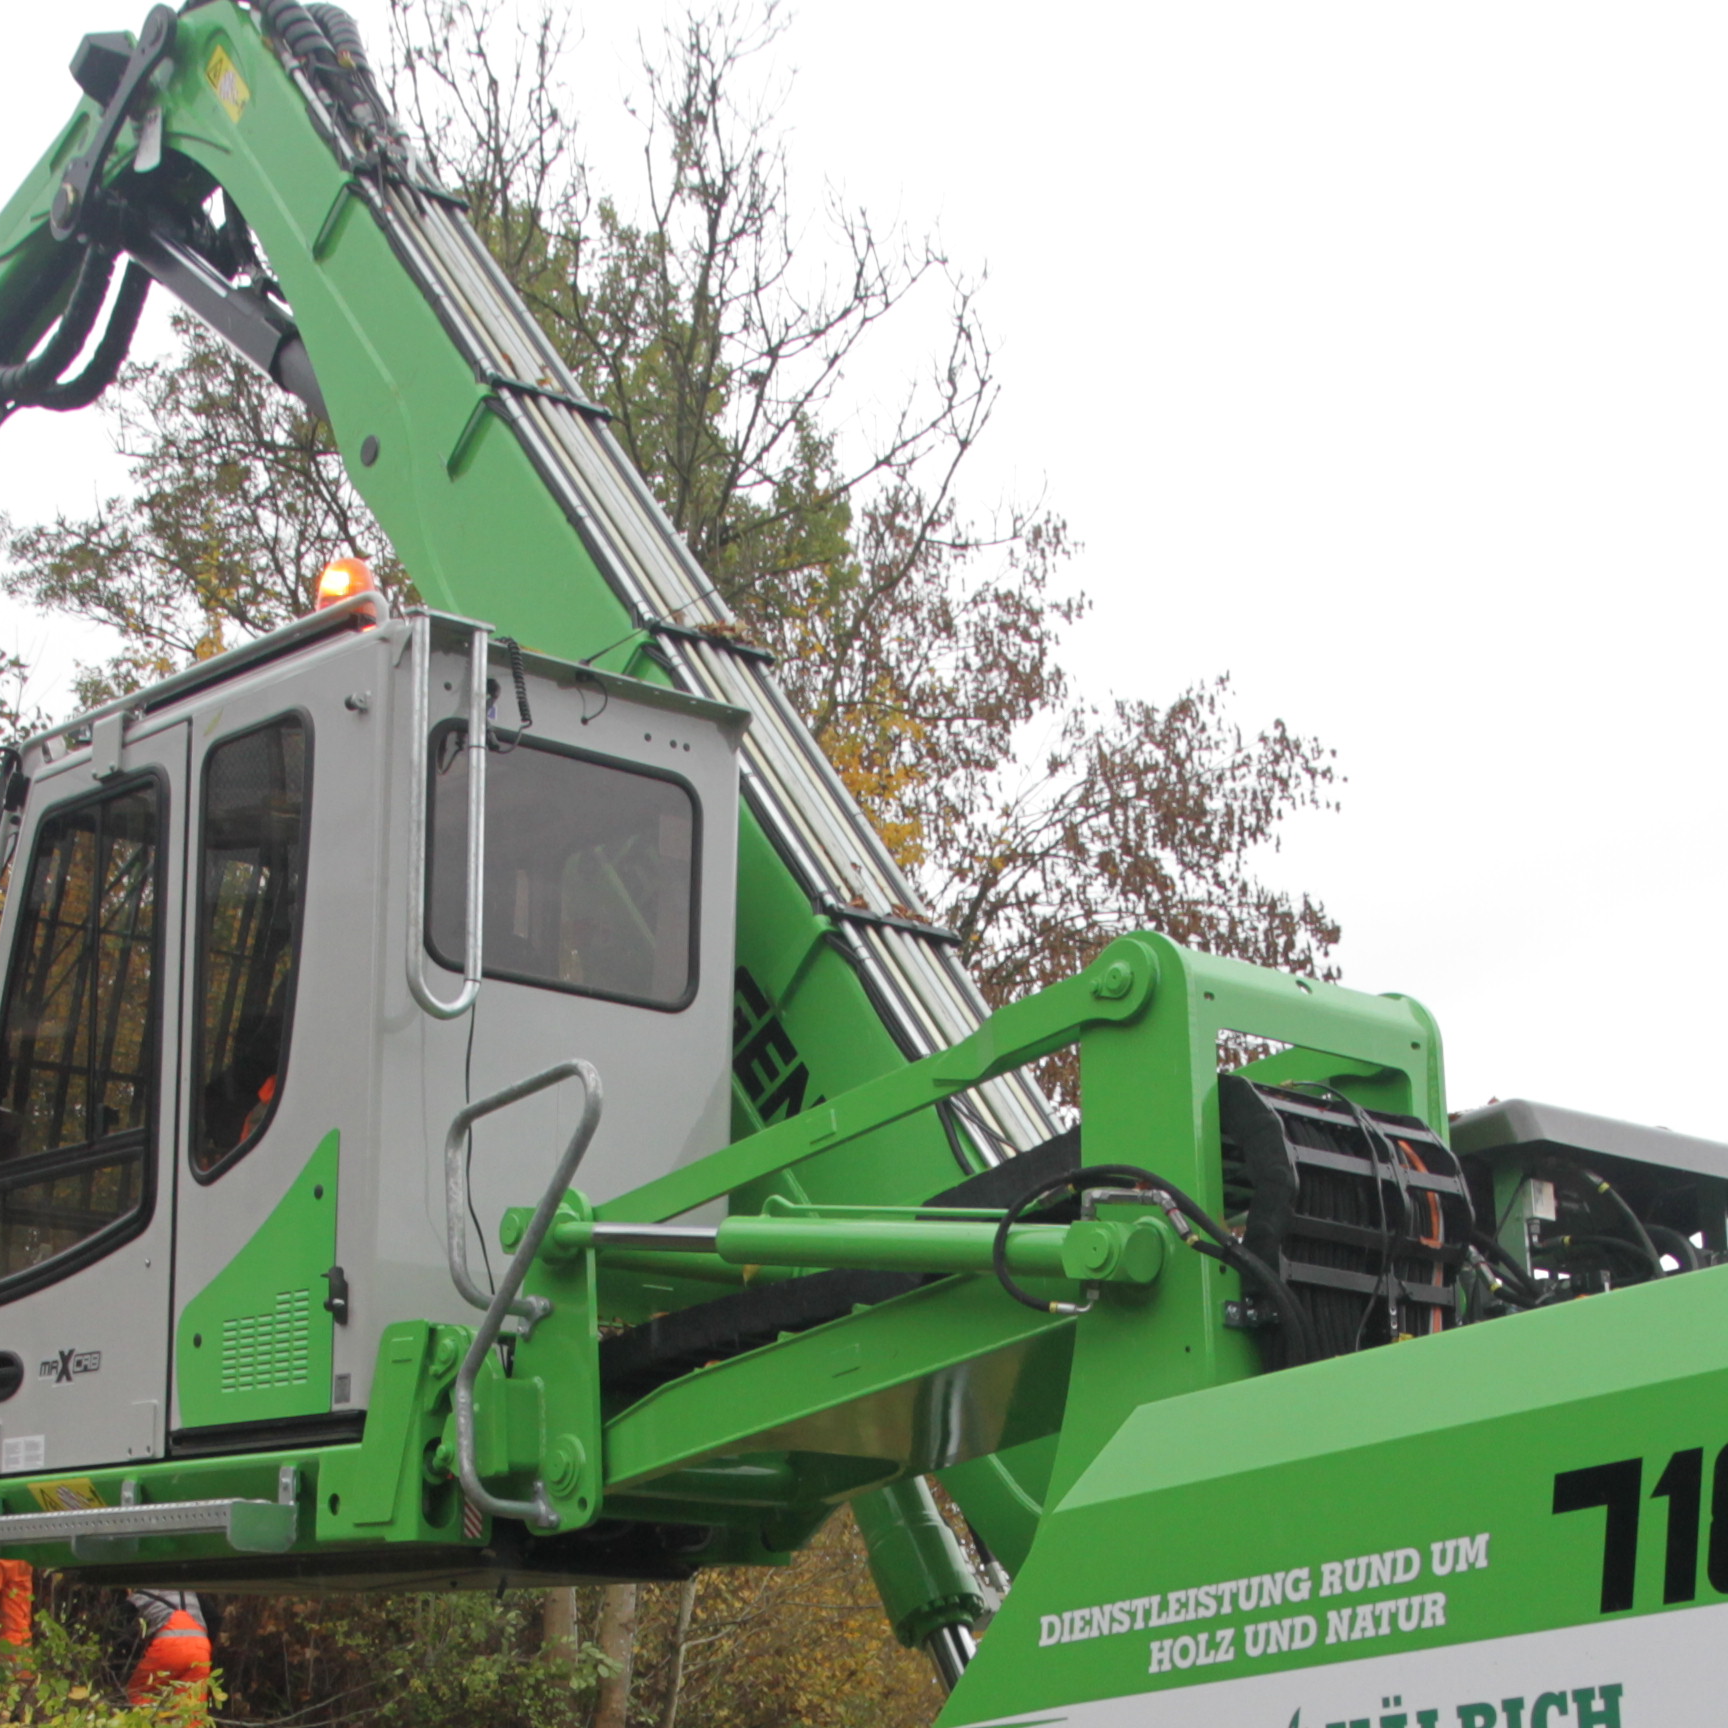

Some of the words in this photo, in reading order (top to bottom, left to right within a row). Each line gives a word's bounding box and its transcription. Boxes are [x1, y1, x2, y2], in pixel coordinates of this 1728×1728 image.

[1038, 1567, 1312, 1647] DIENSTLEISTUNG
[1319, 1547, 1421, 1597] RUND
[1430, 1533, 1490, 1576] UM
[1148, 1628, 1235, 1674] HOLZ
[1244, 1614, 1318, 1658] UND
[1325, 1592, 1447, 1645] NATUR
